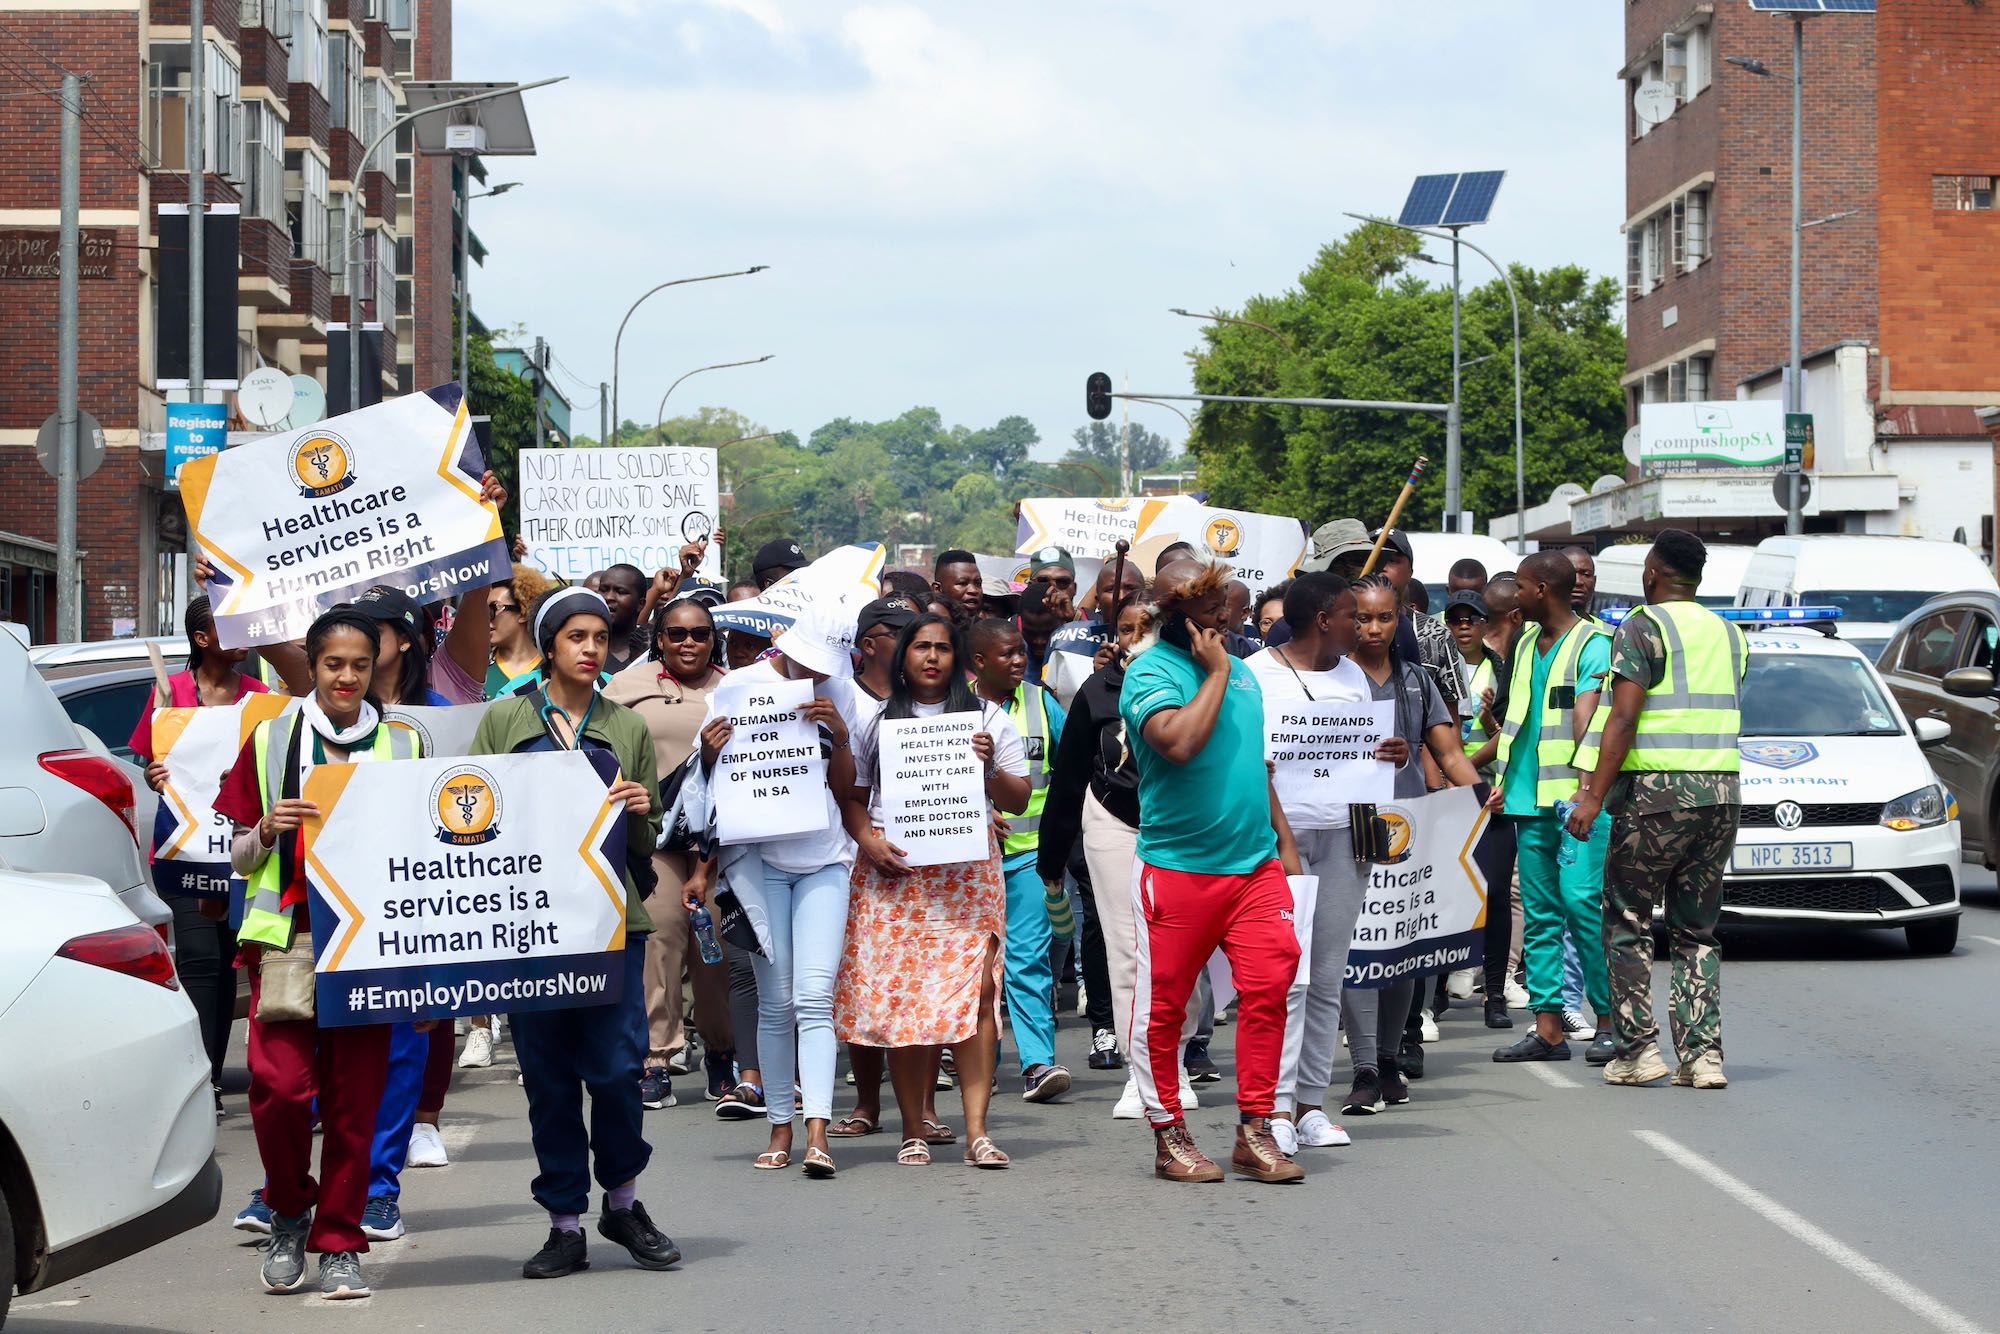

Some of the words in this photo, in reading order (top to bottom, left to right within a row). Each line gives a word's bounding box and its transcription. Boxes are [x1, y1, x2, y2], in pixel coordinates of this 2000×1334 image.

[169, 417, 225, 430] Register
[189, 433, 204, 443] to
[1654, 432, 1773, 453] compushopSA
[174, 444, 218, 455] rescue
[526, 454, 564, 481] NOT
[572, 453, 611, 480] ALL
[617, 452, 710, 480] SOLDIERS
[315, 482, 344, 496] SAMATU
[524, 486, 582, 512] CARRY
[586, 486, 629, 510] GUNS
[634, 485, 653, 508] TO
[662, 484, 706, 508] SAVE
[262, 485, 407, 541] Healthcare
[1064, 509, 1137, 529] Healthca
[524, 517, 572, 542] THEIR
[642, 515, 677, 537] SOME
[266, 526, 373, 571] services
[376, 515, 399, 537] is
[406, 512, 422, 529] a
[267, 560, 361, 599] Human
[366, 535, 435, 570] Right
[826, 636, 842, 647] PSA
[749, 696, 775, 707] PSA
[730, 712, 797, 727] DEMANDS
[1281, 715, 1307, 726] PSA
[1312, 716, 1375, 727] DEMANDS
[896, 727, 918, 736] PSA
[921, 723, 975, 735] DEMANDS
[751, 731, 779, 743] FOR
[900, 740, 944, 750] HEALTH
[947, 737, 970, 747] KZN
[1271, 733, 1359, 744] EMPLOYMENT
[1363, 734, 1381, 743] OF
[721, 746, 815, 765] EMPLOYMENT
[904, 753, 951, 764] INVESTS
[954, 752, 966, 761] IN
[1272, 751, 1295, 761] 700
[1298, 751, 1357, 761] DOCTORS
[1361, 751, 1376, 760] IN
[730, 771, 747, 783] OF
[752, 765, 809, 780] NURSES
[896, 768, 942, 780] QUALITY
[946, 766, 976, 776] CARE
[1313, 768, 1330, 778] SA
[753, 788, 767, 798] IN
[772, 786, 790, 797] SA
[921, 782, 950, 792] WITH
[905, 796, 968, 809] EMPLOYING
[895, 814, 926, 825] MORE
[928, 810, 981, 822] DOCTORS
[452, 833, 486, 844] SAMATU
[904, 829, 926, 839] AND
[929, 826, 973, 837] NURSES
[1751, 847, 1781, 866] NPC
[1792, 846, 1832, 865] 3513
[388, 850, 543, 882] Healthcare
[1367, 864, 1433, 889] thcare
[383, 889, 502, 919] services
[509, 887, 531, 912] is
[534, 890, 550, 910] a
[1410, 891, 1420, 910] is
[1423, 889, 1435, 904] a
[1395, 913, 1439, 940] Right
[378, 930, 482, 957] Human
[492, 920, 558, 953] Right
[348, 971, 607, 1012] #EmployDoctorsNow
